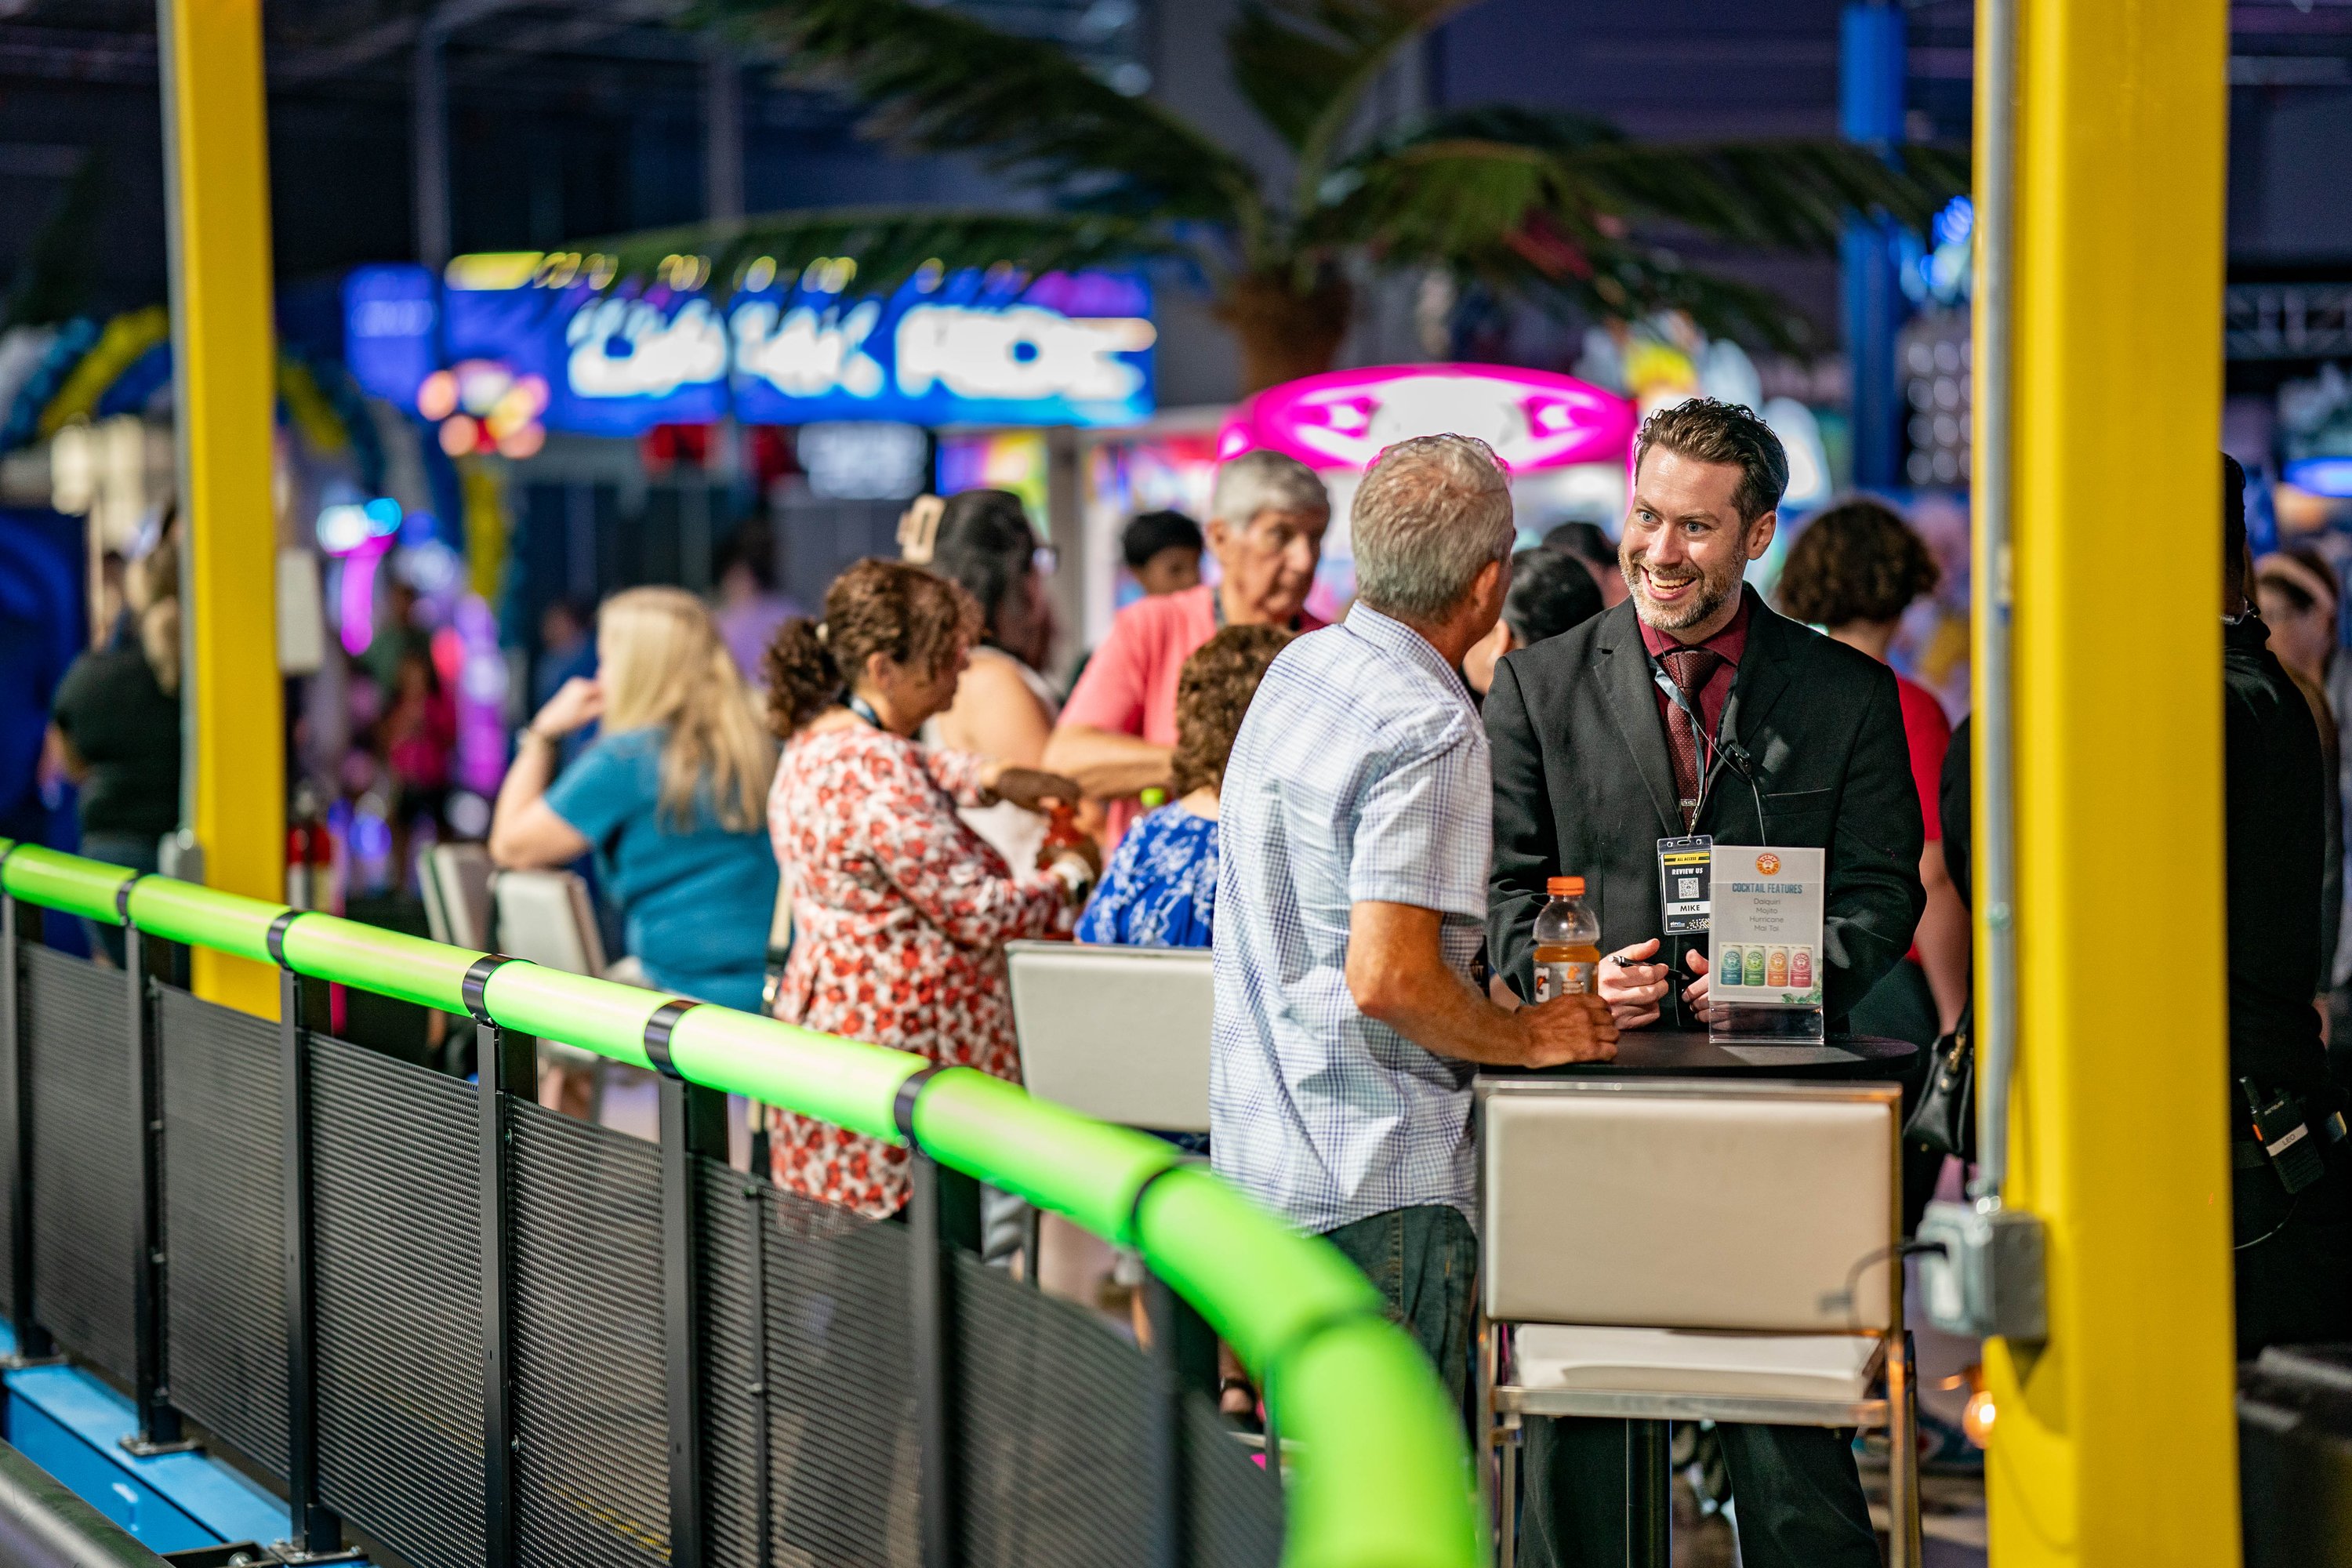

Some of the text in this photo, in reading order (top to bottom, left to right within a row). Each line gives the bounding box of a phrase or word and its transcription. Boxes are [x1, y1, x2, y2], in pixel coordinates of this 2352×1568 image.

[1732, 883, 1802, 894] COCKTAIL FEATURES
[2281, 1134, 2296, 1145] LEO
